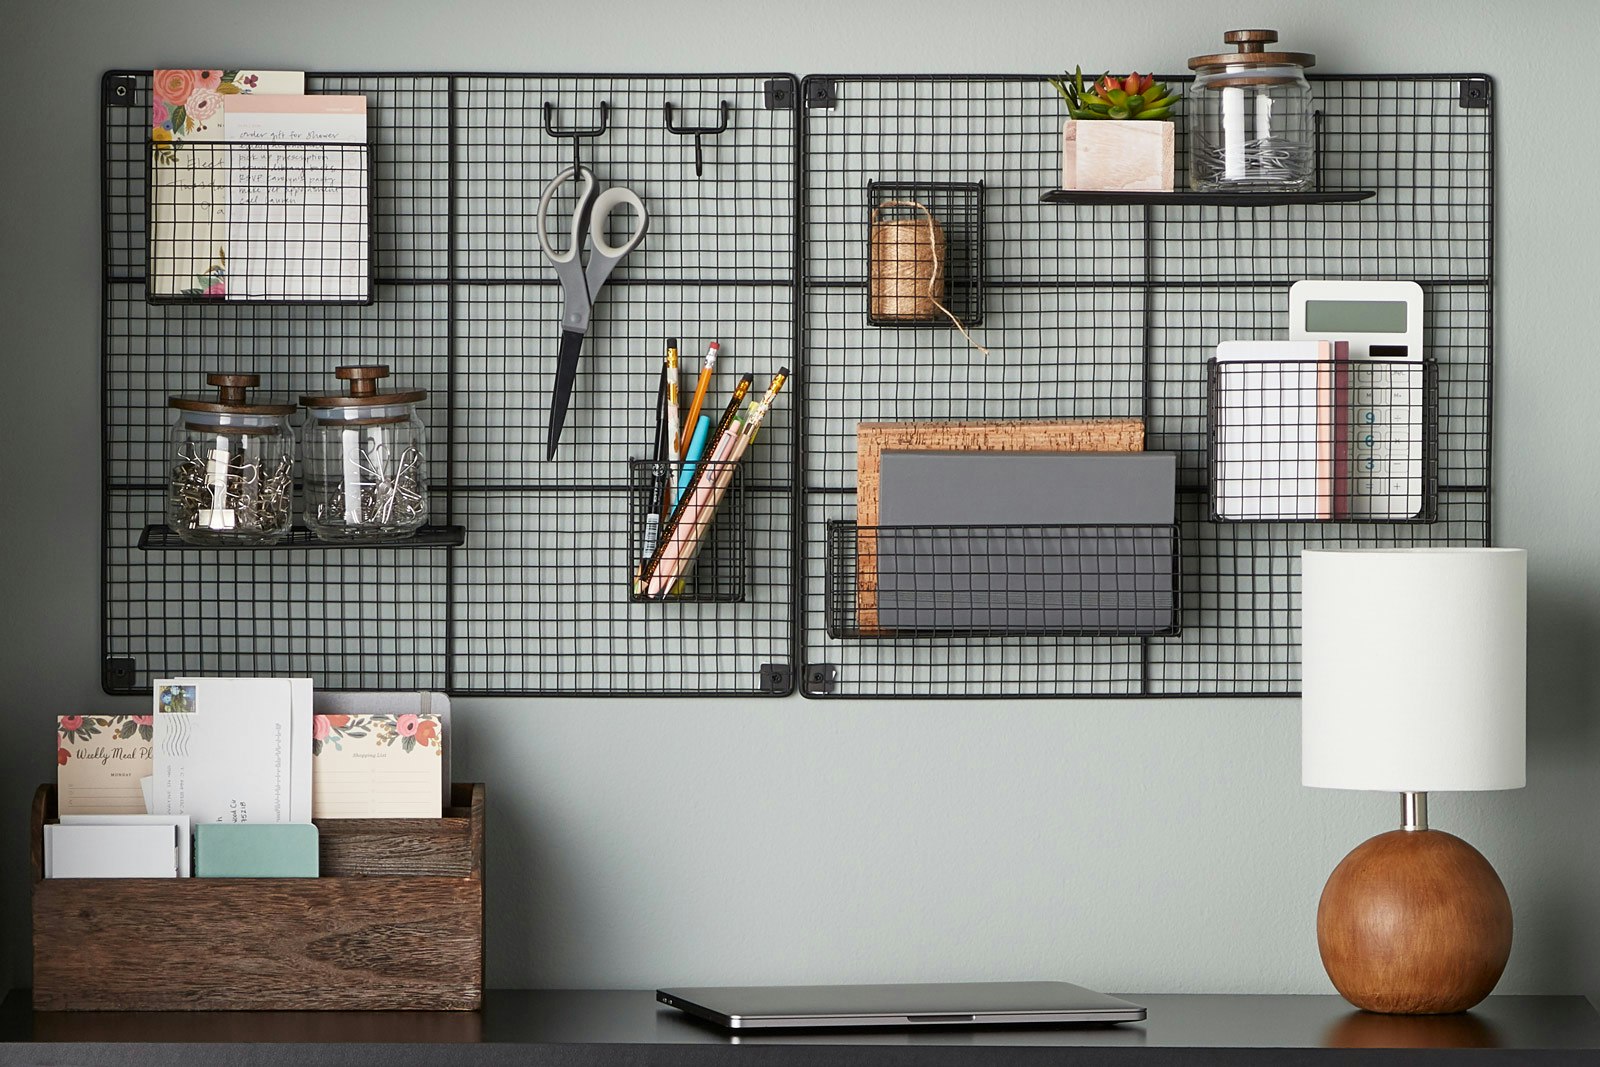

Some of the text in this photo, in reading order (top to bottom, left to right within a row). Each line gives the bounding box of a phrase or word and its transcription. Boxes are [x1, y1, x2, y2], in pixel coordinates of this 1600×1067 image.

[290, 130, 302, 139] for
[276, 153, 329, 165] prescrption
[267, 174, 305, 186] Caroyn's
[1365, 412, 1375, 425] 9
[1365, 435, 1375, 447] 6
[1365, 457, 1375, 470] 3
[76, 747, 110, 766] Weekly
[111, 747, 137, 760] Meal
